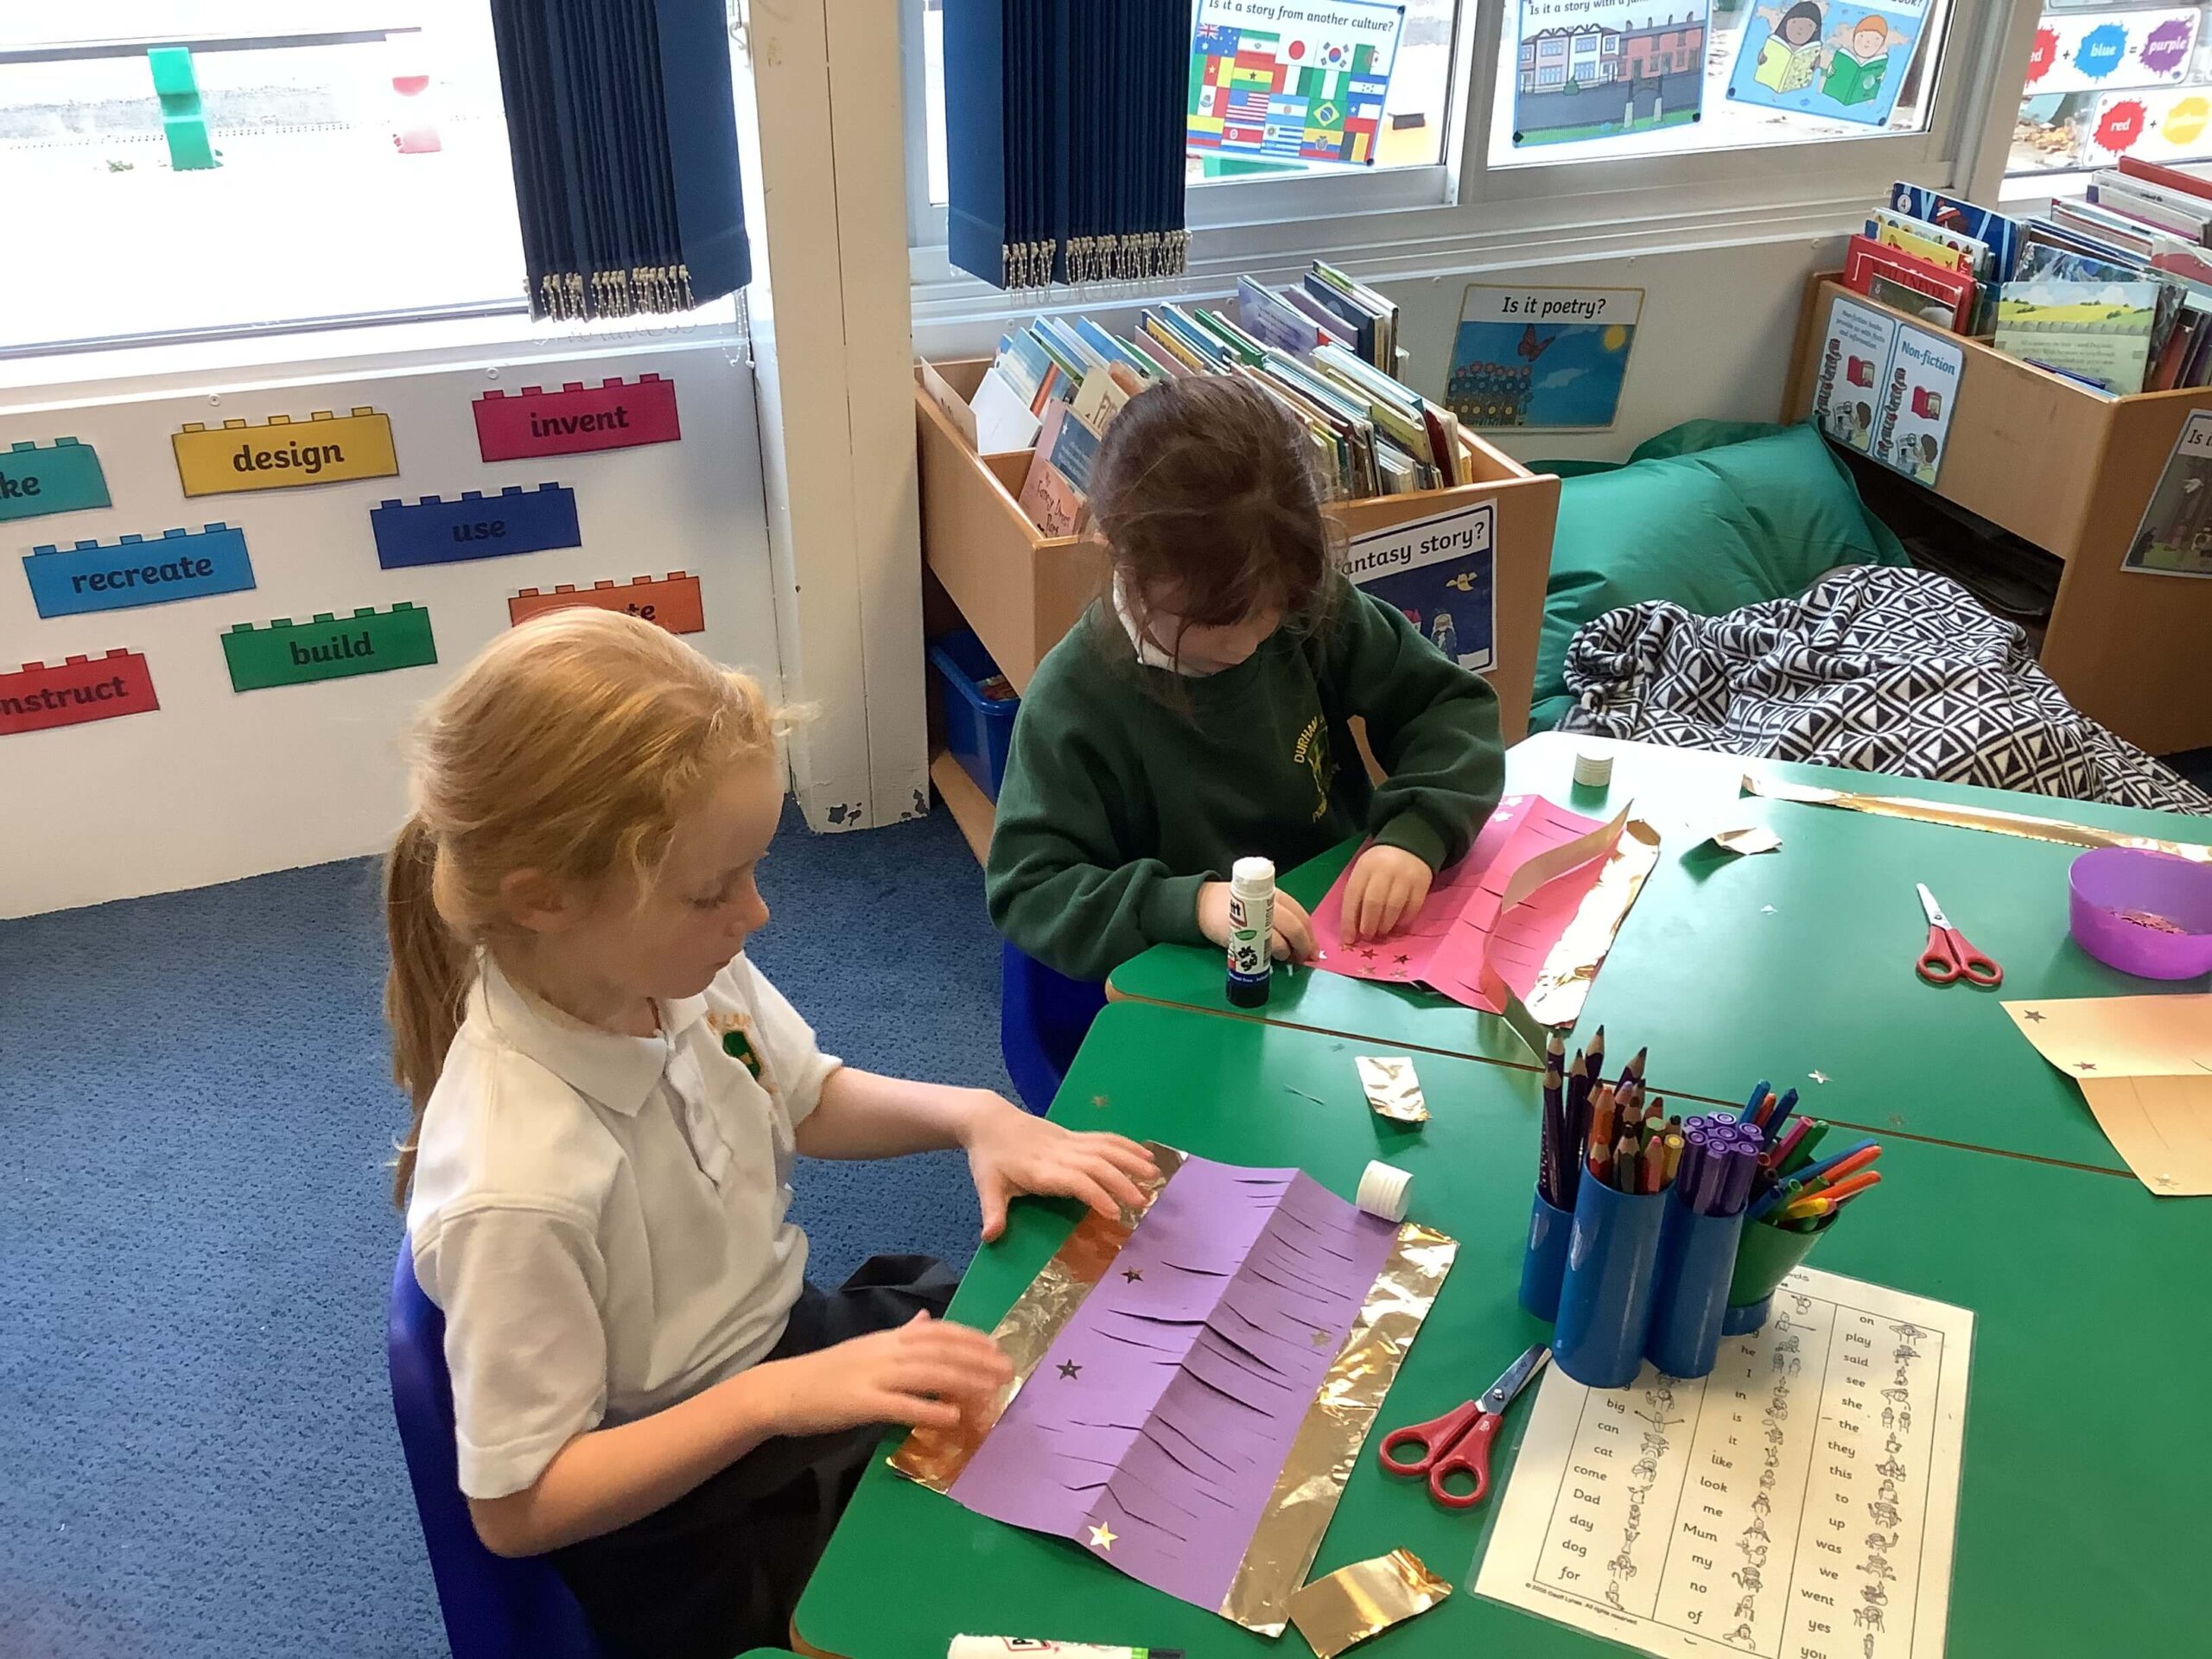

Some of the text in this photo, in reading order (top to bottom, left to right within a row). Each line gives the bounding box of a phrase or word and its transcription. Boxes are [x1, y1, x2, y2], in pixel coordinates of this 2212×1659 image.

[1529, 5, 1540, 16] Is
[1542, 3, 1550, 14] it
[1564, 1, 1590, 12] story
[1246, 3, 1275, 19] story
[1277, 5, 1304, 21] from
[1306, 10, 1349, 26] another
[1351, 17, 1394, 32] culture?
[2090, 43, 2116, 57] blue
[2149, 36, 2187, 54] purple
[2111, 118, 2131, 131] red
[1502, 296, 1606, 319] Is it poetry?
[1901, 340, 1956, 376] Non-fiction
[530, 405, 629, 438] invent
[2187, 429, 2203, 445] Is
[232, 441, 345, 476] design
[0, 472, 41, 499] ke
[453, 519, 506, 543] use
[1334, 521, 1484, 576] antasy story?
[71, 556, 214, 594] recreate
[289, 631, 375, 666] build
[0, 676, 129, 715] nstruct
[1859, 1316, 1875, 1325] on
[1845, 1332, 1872, 1348] play
[1741, 1345, 1756, 1357] he
[1844, 1354, 1869, 1367] said
[1746, 1369, 1751, 1378] I
[1846, 1376, 1866, 1388] see
[1735, 1390, 1747, 1400] in
[1606, 1398, 1625, 1414] big
[1841, 1397, 1863, 1410] she
[1732, 1412, 1742, 1422] is
[1598, 1422, 1619, 1434] can
[1839, 1420, 1859, 1433] the
[1728, 1435, 1738, 1446] it
[1593, 1446, 1613, 1459] cat
[1827, 1441, 1856, 1459] they
[1712, 1454, 1733, 1469] like
[1573, 1465, 1607, 1481] come
[1829, 1465, 1853, 1480] this
[1700, 1476, 1727, 1493] look
[1573, 1488, 1601, 1505] Dad
[1835, 1493, 1849, 1503] to
[1703, 1505, 1723, 1517] me
[1569, 1515, 1594, 1532] day
[1828, 1517, 1846, 1530] up
[1683, 1522, 1718, 1542] Mum
[1562, 1540, 1587, 1557] dog
[1815, 1539, 1842, 1554] was
[1692, 1554, 1713, 1570] my
[1558, 1566, 1580, 1580] for
[1819, 1567, 1839, 1580] we
[1689, 1581, 1707, 1593] no
[1801, 1588, 1834, 1606] went
[1688, 1611, 1703, 1624] of
[1808, 1619, 1831, 1633] yes
[1800, 1647, 1827, 1659] you
